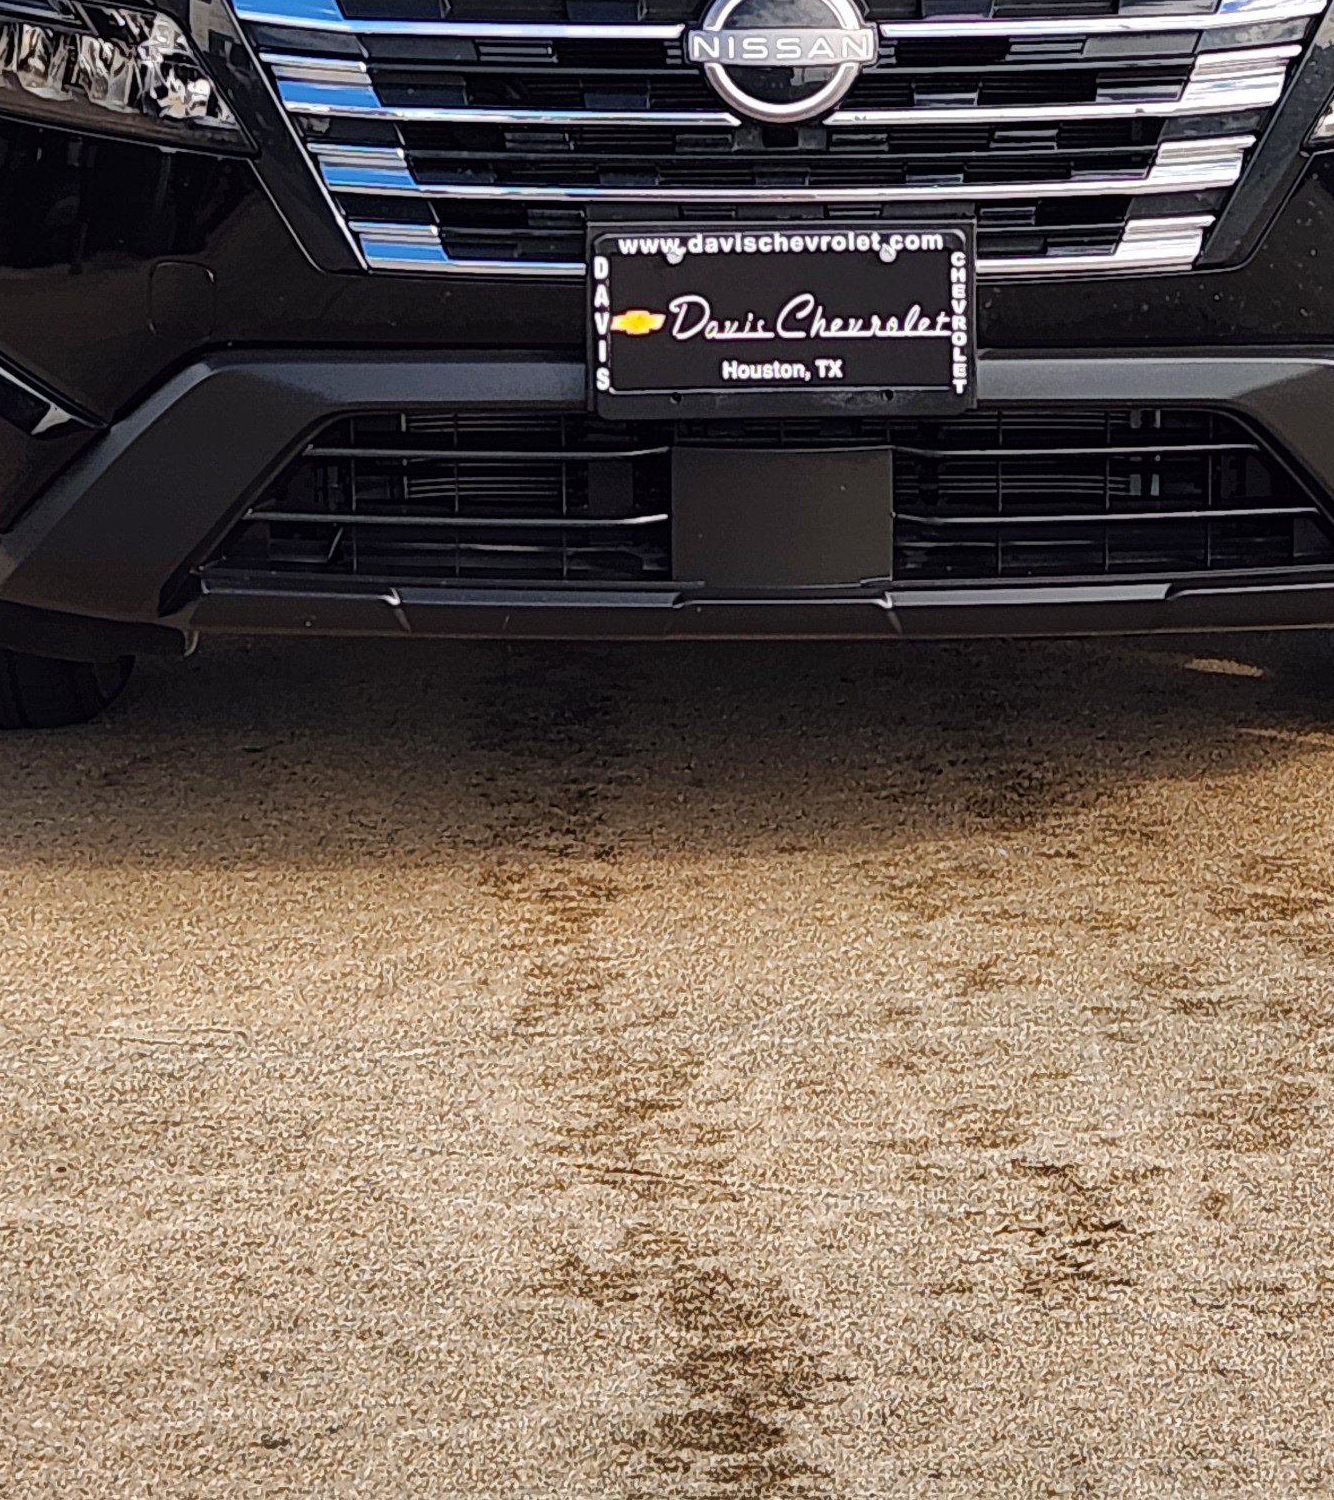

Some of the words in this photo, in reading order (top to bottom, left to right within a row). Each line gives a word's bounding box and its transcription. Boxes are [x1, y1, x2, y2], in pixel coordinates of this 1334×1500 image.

[693, 35, 867, 60] NISSAN
[618, 231, 944, 255] www.davischevrolet.com
[593, 255, 611, 391] DAVIS
[668, 294, 775, 341] Davis
[776, 293, 953, 340] Chevrolet
[950, 251, 968, 394] CHEVROLET
[721, 360, 812, 382] Houston,
[814, 358, 844, 379] TX
